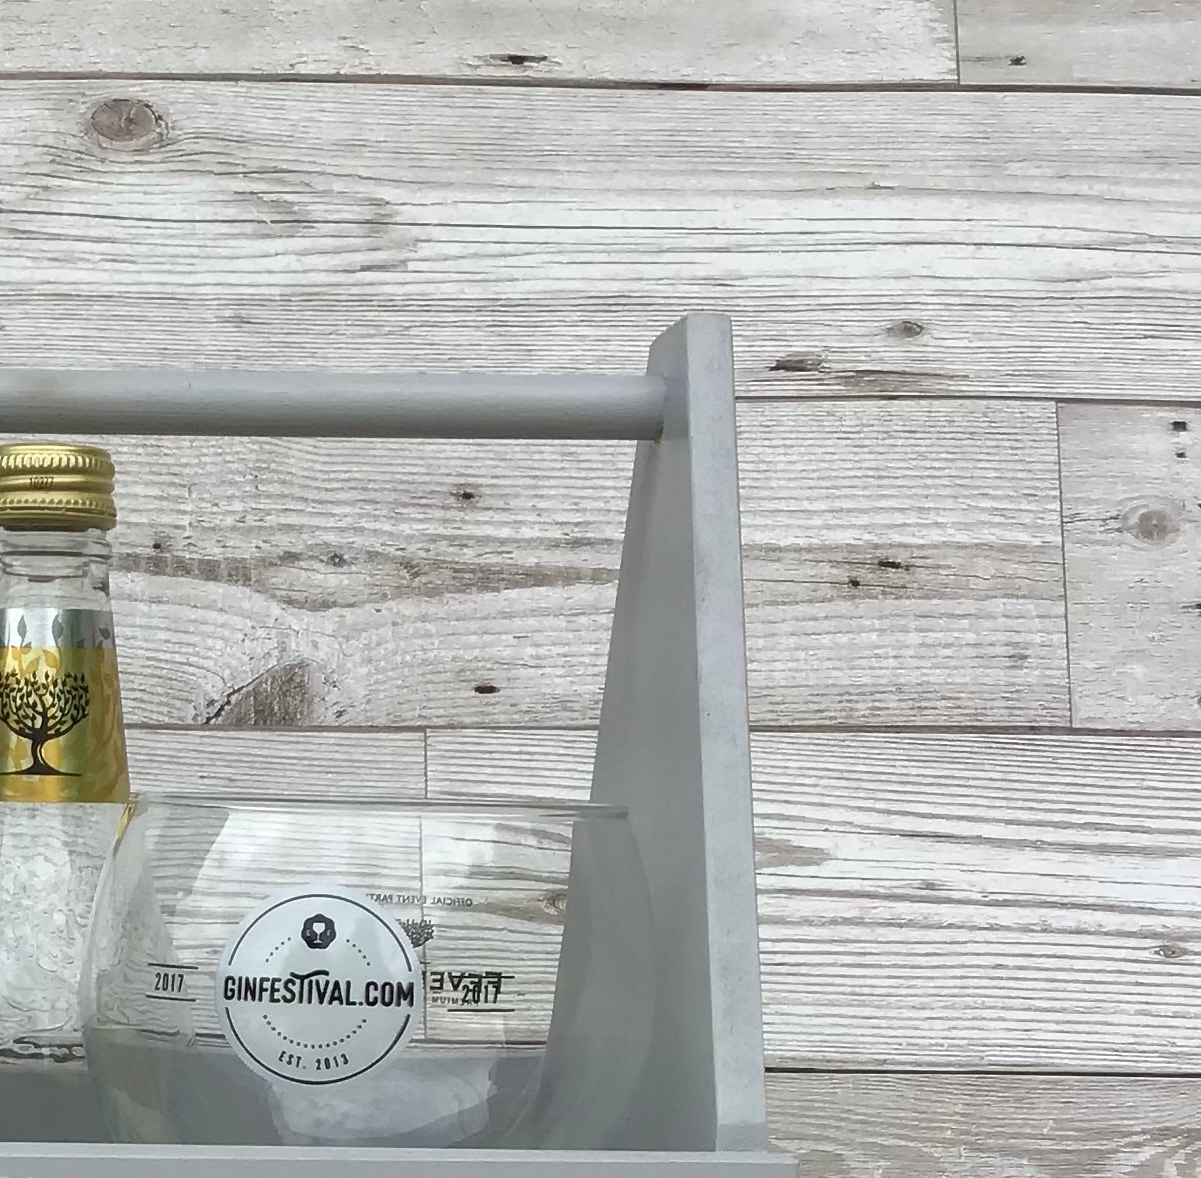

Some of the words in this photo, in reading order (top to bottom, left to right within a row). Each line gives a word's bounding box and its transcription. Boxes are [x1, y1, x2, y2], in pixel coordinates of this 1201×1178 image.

[154, 972, 185, 993] 2017
[223, 970, 415, 1008] GINFESTIVAL.COM
[461, 984, 500, 1004] 2017
[278, 1050, 306, 1069] EST.
[315, 1053, 349, 1071] 2013
